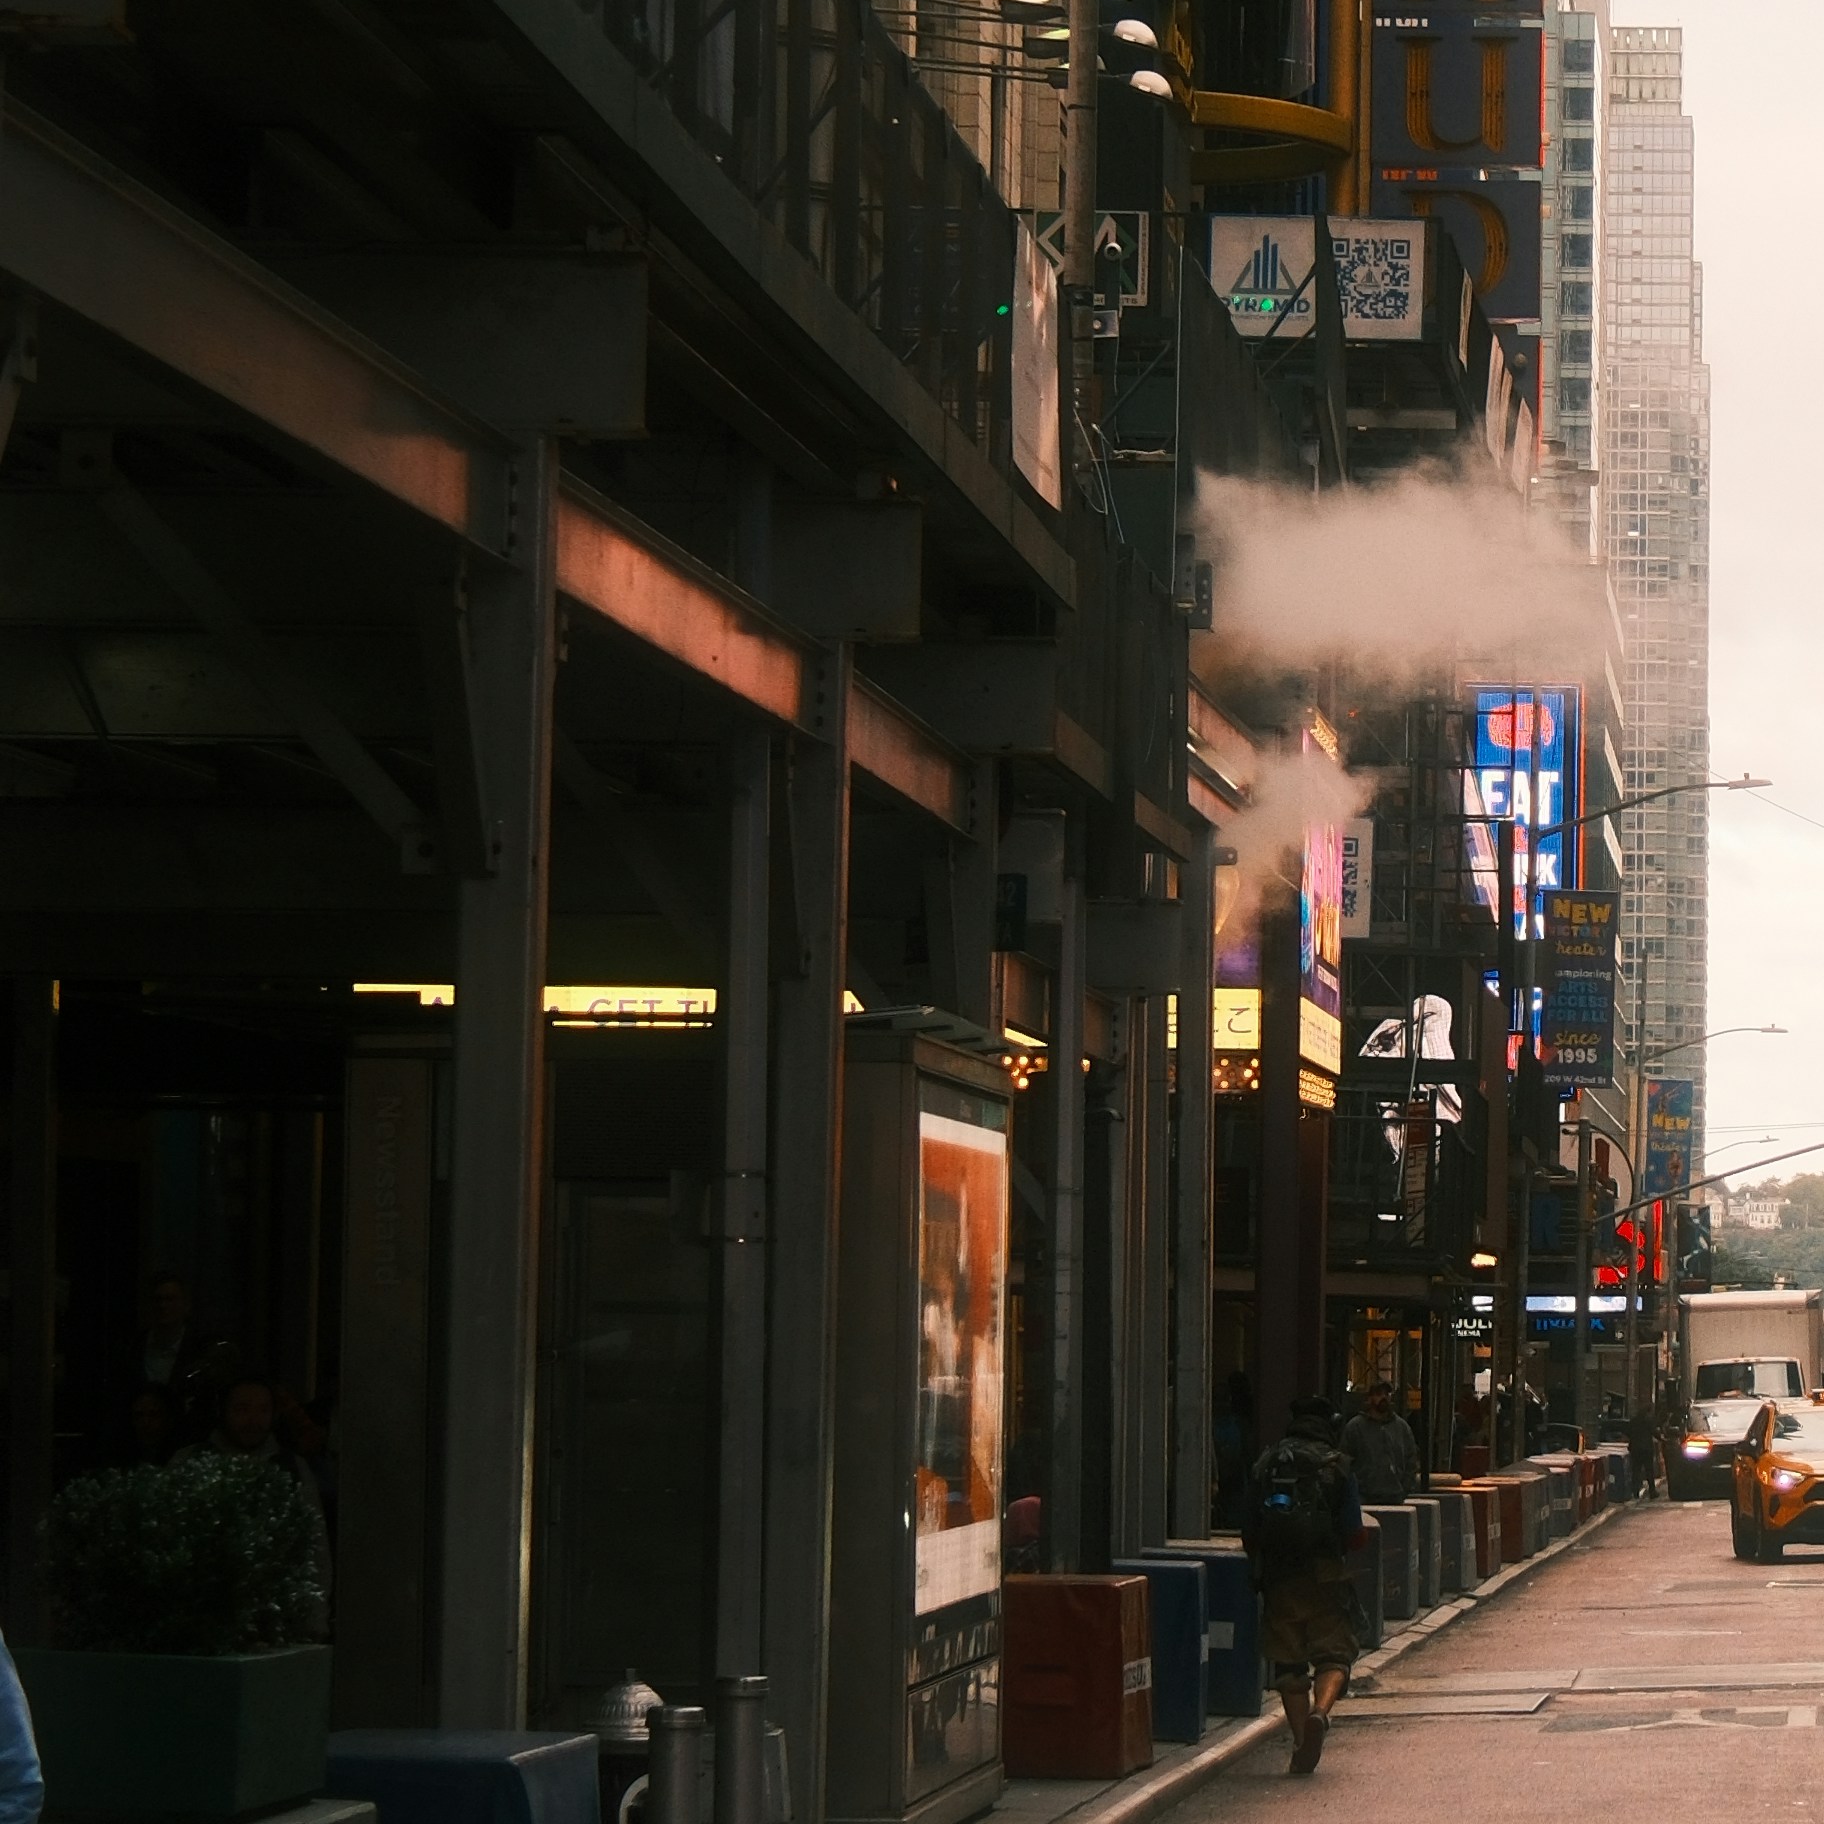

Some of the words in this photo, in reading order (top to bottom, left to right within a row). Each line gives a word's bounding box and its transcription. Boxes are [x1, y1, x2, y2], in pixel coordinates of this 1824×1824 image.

[1553, 898, 1612, 925] NEW
[1554, 1031, 1602, 1046] since
[1556, 1047, 1599, 1065] 1995
[1651, 1112, 1691, 1131] NEW
[375, 1095, 401, 1285] Newsstand
